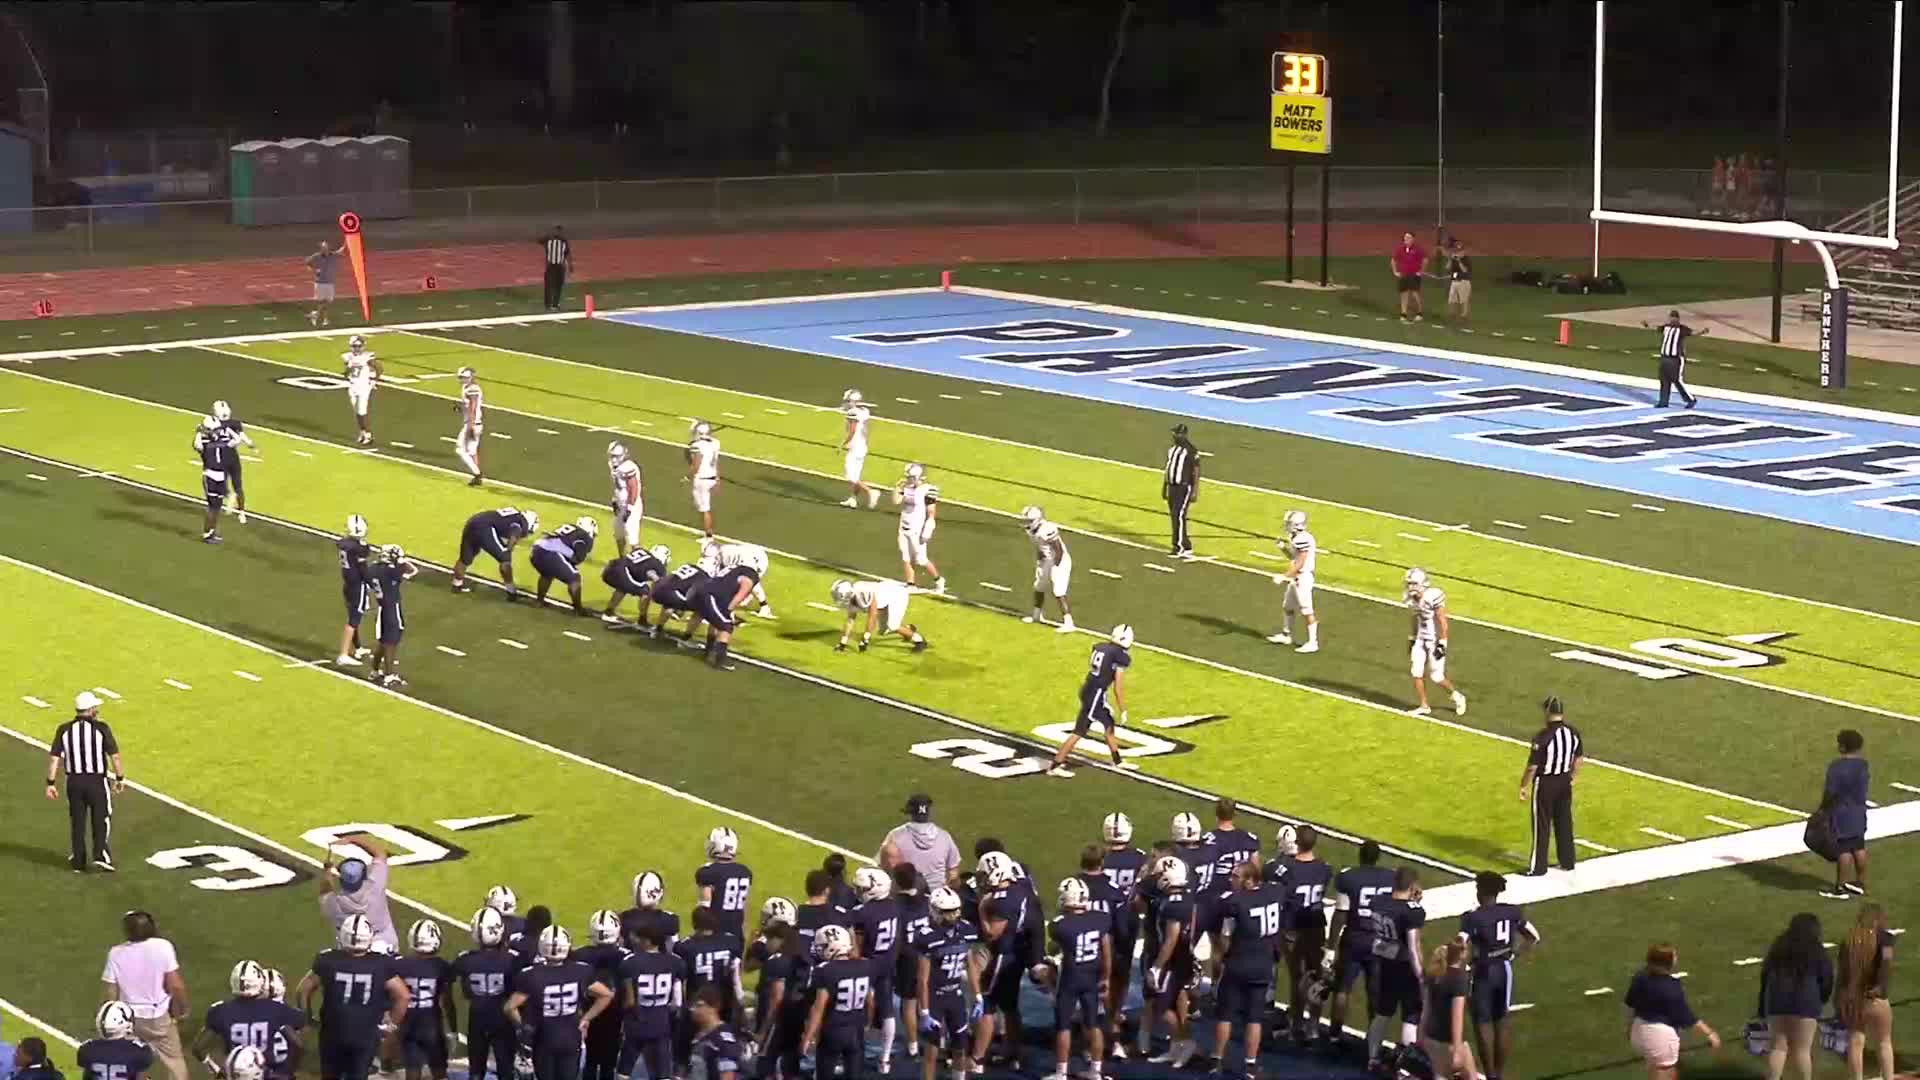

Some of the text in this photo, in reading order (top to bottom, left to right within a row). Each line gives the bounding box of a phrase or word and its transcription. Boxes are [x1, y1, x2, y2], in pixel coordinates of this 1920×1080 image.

[1282, 55, 1317, 93] 33
[1274, 116, 1323, 132] BOWERS
[1283, 104, 1315, 117] MATT
[1820, 292, 1832, 386] PANTHERS
[1550, 637, 1773, 680] 10
[908, 721, 1177, 778] 20
[145, 822, 450, 891] 30
[722, 878, 750, 910] 82
[874, 916, 897, 951] 21
[1249, 902, 1279, 938] 78
[1496, 919, 1510, 944] 4
[1075, 930, 1100, 962] 15
[335, 972, 372, 1004] 77
[638, 973, 672, 1007] 29
[834, 976, 869, 1012] 38
[230, 1022, 268, 1049] 90
